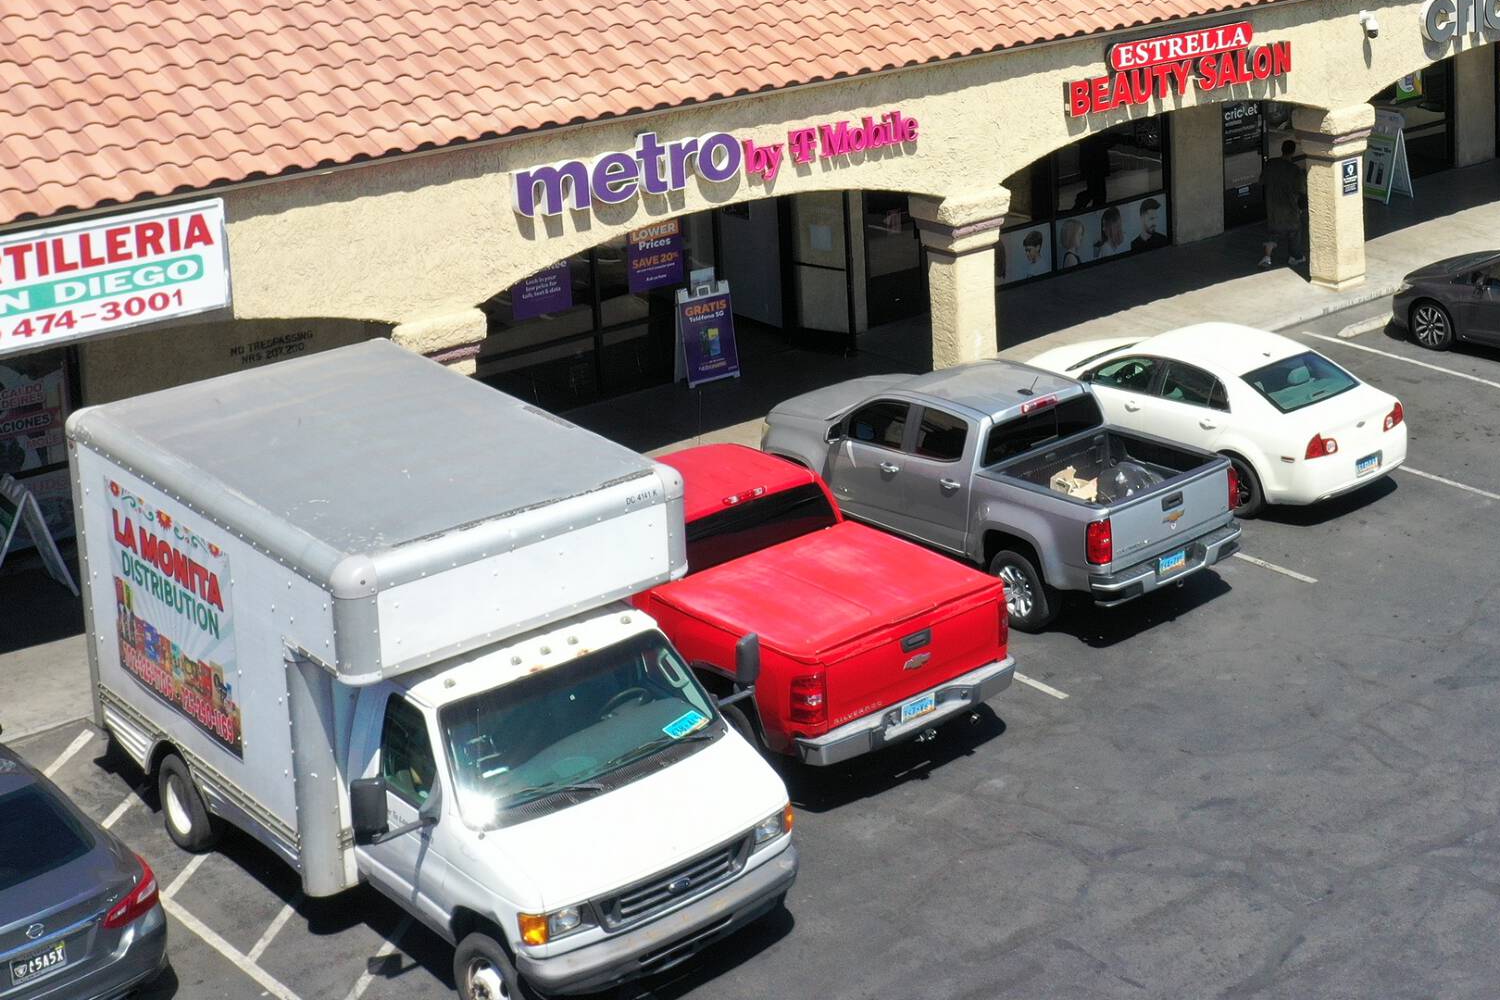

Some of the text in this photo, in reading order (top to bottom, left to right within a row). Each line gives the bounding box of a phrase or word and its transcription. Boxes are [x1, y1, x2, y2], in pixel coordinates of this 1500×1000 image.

[1118, 27, 1248, 67] ESTRELLA
[1070, 41, 1292, 118] BEAUTY SALON
[1224, 103, 1258, 121] cricket
[513, 131, 742, 217] metro
[741, 138, 784, 181] by
[0, 213, 214, 284] TILLERIA
[632, 222, 676, 242] LOWER
[639, 238, 671, 251] Prices
[53, 259, 199, 304] DIEGO
[632, 256, 660, 270] SAVE
[11, 288, 184, 338] 474-3001
[685, 299, 727, 317] GRATIS
[112, 507, 224, 612] LA MONITA
[121, 549, 220, 640] DISTRIBUTION
